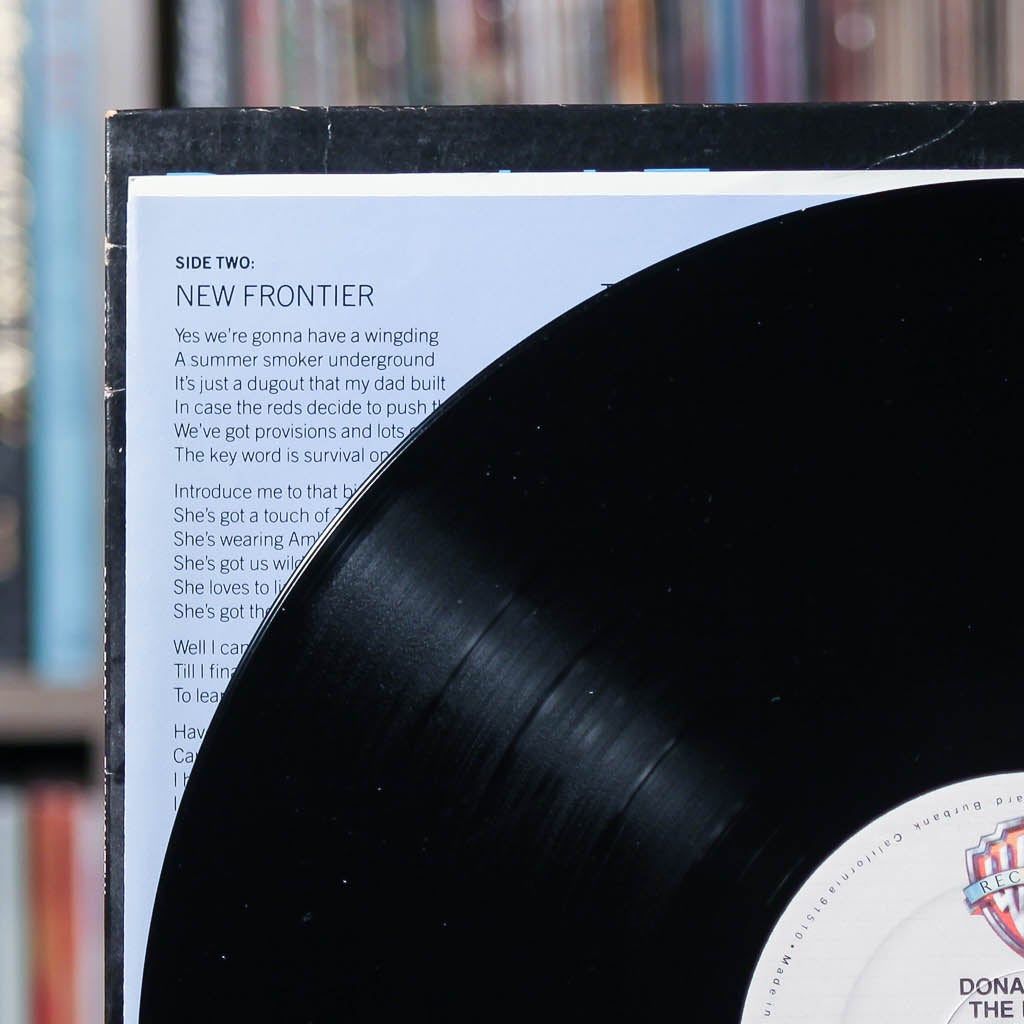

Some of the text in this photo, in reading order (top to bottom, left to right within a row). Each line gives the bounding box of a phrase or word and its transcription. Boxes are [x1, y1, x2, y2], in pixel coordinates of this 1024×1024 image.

[175, 255, 254, 269] SIDE TWO:
[177, 284, 373, 307] NEW FRONTIER
[174, 327, 439, 347] Yes we're gonna have a wingding
[174, 351, 434, 370] A summer smoker underground
[175, 375, 446, 394] It's just a dugout that my dad built
[175, 399, 189, 414] In
[194, 402, 231, 415] case
[237, 399, 262, 415] the
[267, 399, 302, 415] reds
[306, 399, 361, 415] decide
[366, 399, 381, 415] to
[387, 399, 427, 418] push
[173, 422, 220, 438] We've
[225, 423, 249, 442] got
[255, 423, 336, 442] provisions
[341, 423, 371, 438] and
[378, 423, 405, 439] lots
[174, 446, 204, 462] The
[210, 447, 237, 466] key
[241, 447, 280, 463] word
[287, 447, 299, 463] is
[304, 447, 364, 463] survival
[174, 483, 252, 499] Introduce
[257, 487, 282, 499] me
[287, 484, 302, 499] to
[306, 483, 337, 499] that
[173, 530, 215, 547] She's
[219, 532, 283, 551] wearing
[173, 578, 204, 595] She
[209, 579, 249, 595] loves
[254, 580, 269, 595] to
[968, 1000, 1014, 1018] THE
